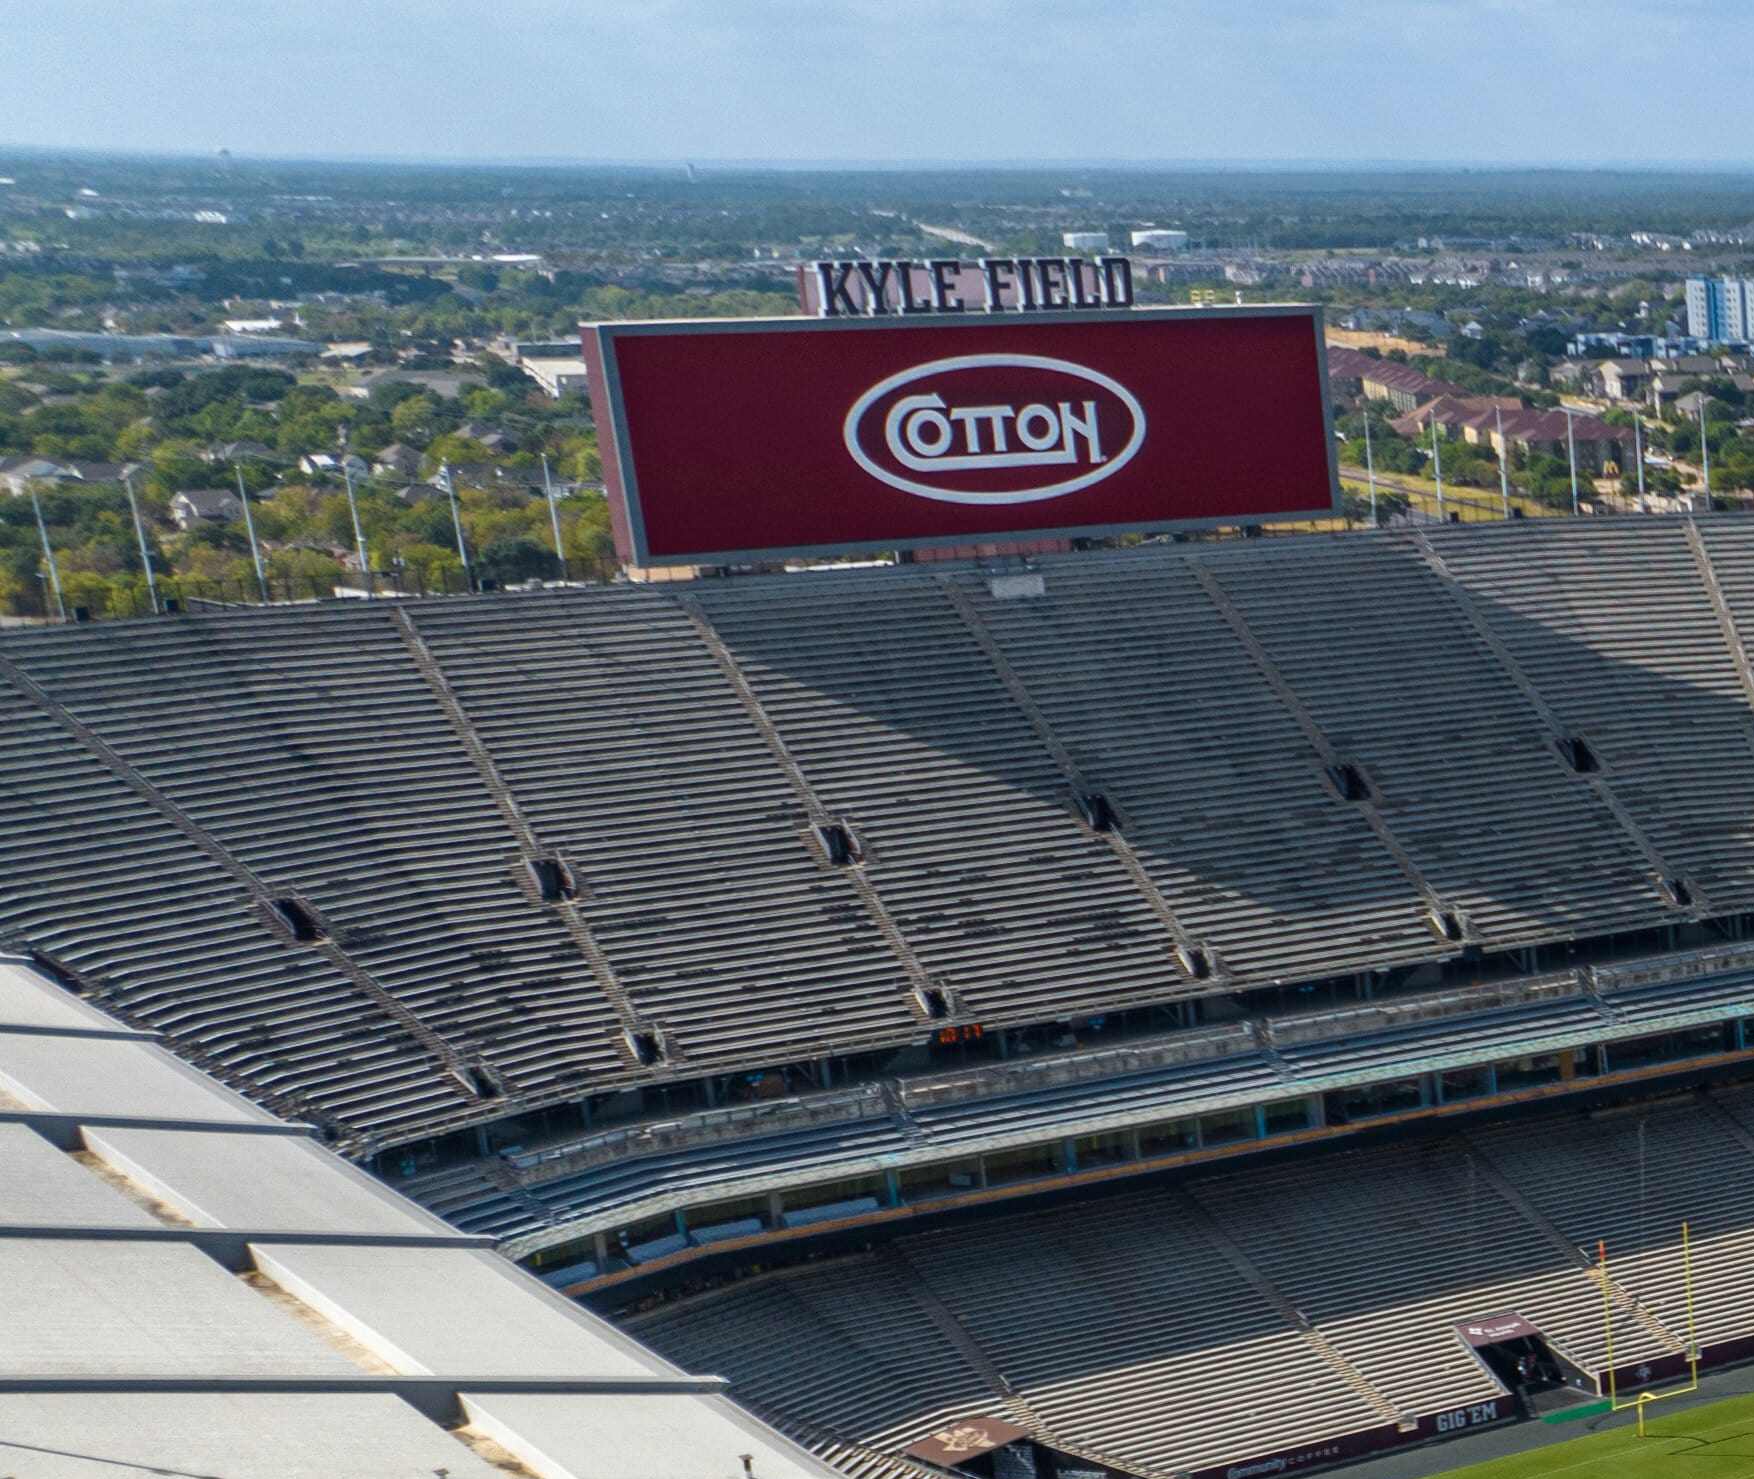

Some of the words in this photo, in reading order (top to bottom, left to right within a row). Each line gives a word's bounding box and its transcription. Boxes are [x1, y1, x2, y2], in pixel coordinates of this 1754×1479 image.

[814, 259, 964, 318] KYLE
[977, 257, 1134, 314] FIELD
[886, 392, 1101, 472] COTTON
[1436, 1410, 1467, 1432] GIG
